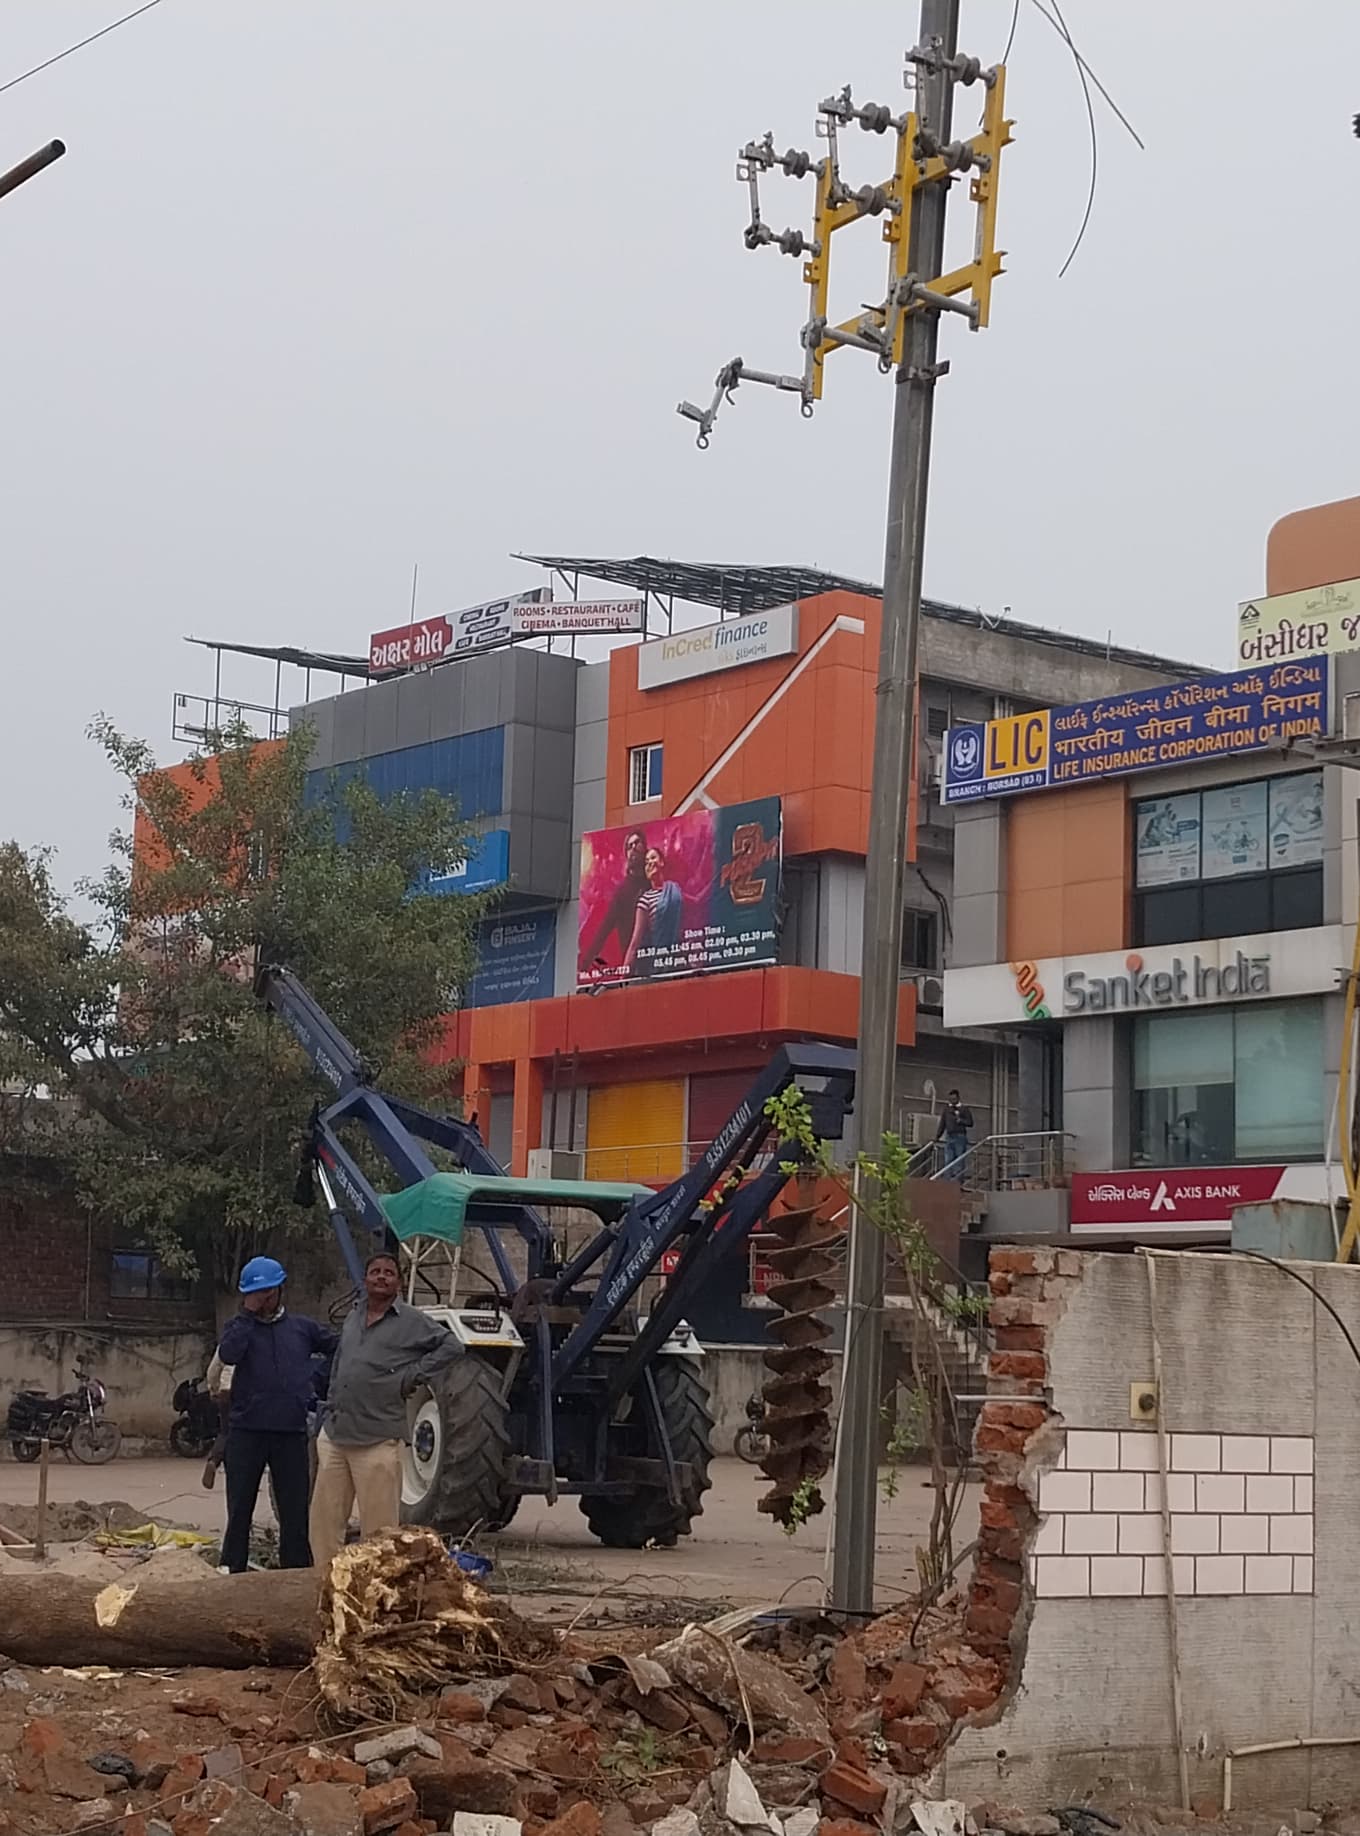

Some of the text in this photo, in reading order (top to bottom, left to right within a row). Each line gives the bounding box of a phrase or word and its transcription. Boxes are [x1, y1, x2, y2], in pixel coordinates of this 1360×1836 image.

[513, 607, 546, 619] ROOMS
[551, 604, 612, 617] RESTAURANT
[561, 617, 604, 630] BANQUET
[370, 625, 445, 669] અક્ષર મોલ
[714, 620, 768, 650] finance
[1240, 618, 1329, 661] બંસીધર
[1269, 665, 1321, 689] ઈન્ડિયા
[1054, 692, 1322, 756] भारतीय जीवन बीमा निगम
[990, 717, 1043, 772] LIC
[1053, 717, 1321, 779] LIFE INSURANCE CORPORATION OF INDIA
[948, 785, 981, 799] BRANCH
[1063, 953, 1188, 1013] Sanket
[1174, 1185, 1240, 1199] AXIS BANK
